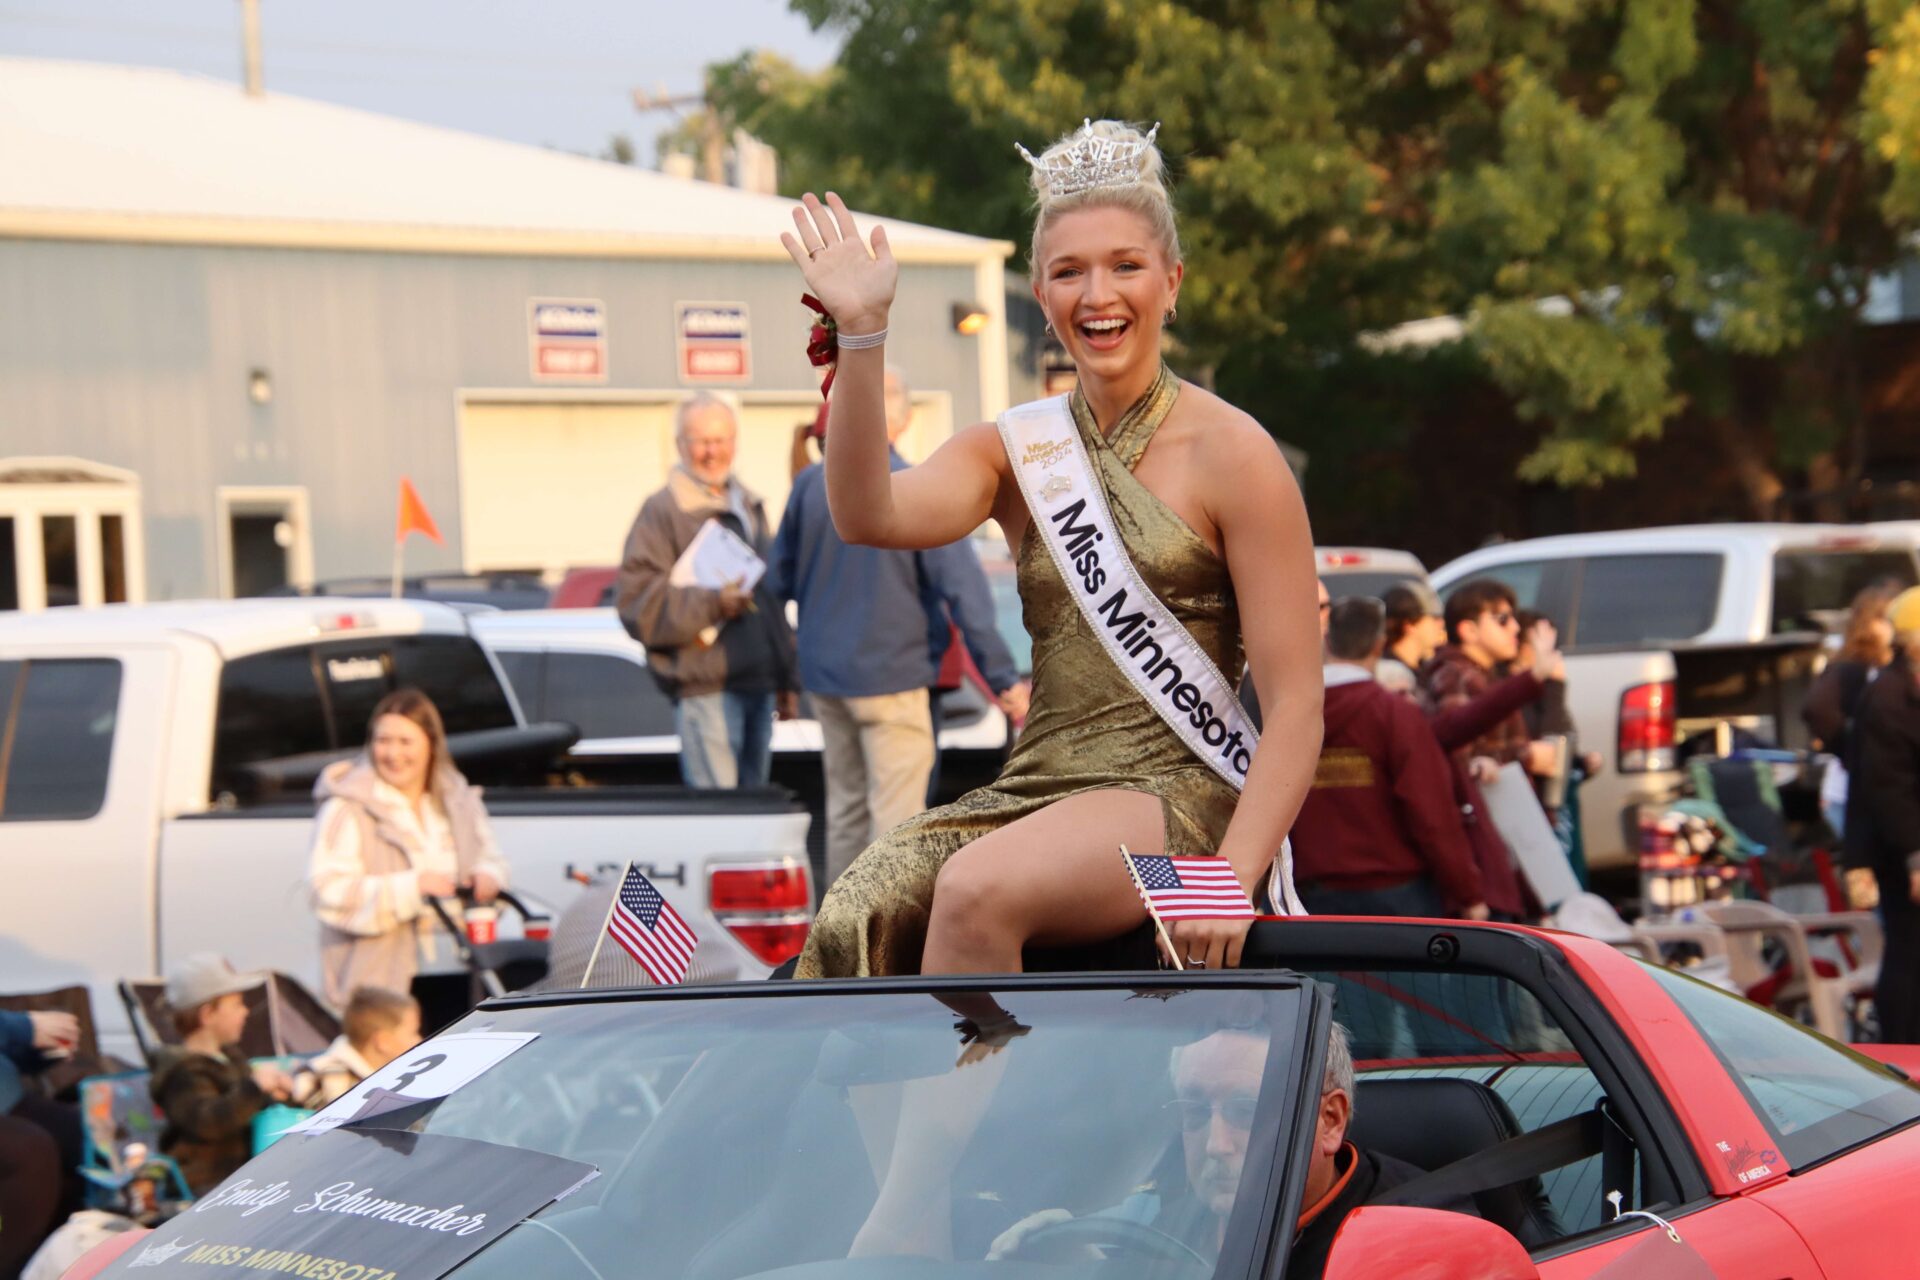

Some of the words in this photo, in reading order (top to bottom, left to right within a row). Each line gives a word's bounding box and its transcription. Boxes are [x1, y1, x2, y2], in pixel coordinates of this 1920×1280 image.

[1023, 438, 1072, 465] America
[1026, 440, 1055, 453] Miss
[1040, 447, 1072, 469] 2024
[1051, 498, 1106, 595] Miss
[1098, 588, 1251, 777] Minnesota
[362, 1054, 447, 1099] 3
[1716, 1141, 1731, 1153] THE
[1738, 1172, 1749, 1183] OF
[1746, 1165, 1772, 1181] AMERICA
[195, 1179, 290, 1216] Emily
[294, 1181, 488, 1236] Schumacher
[181, 1244, 249, 1265] MISS
[240, 1248, 398, 1280] MINNESOTA
